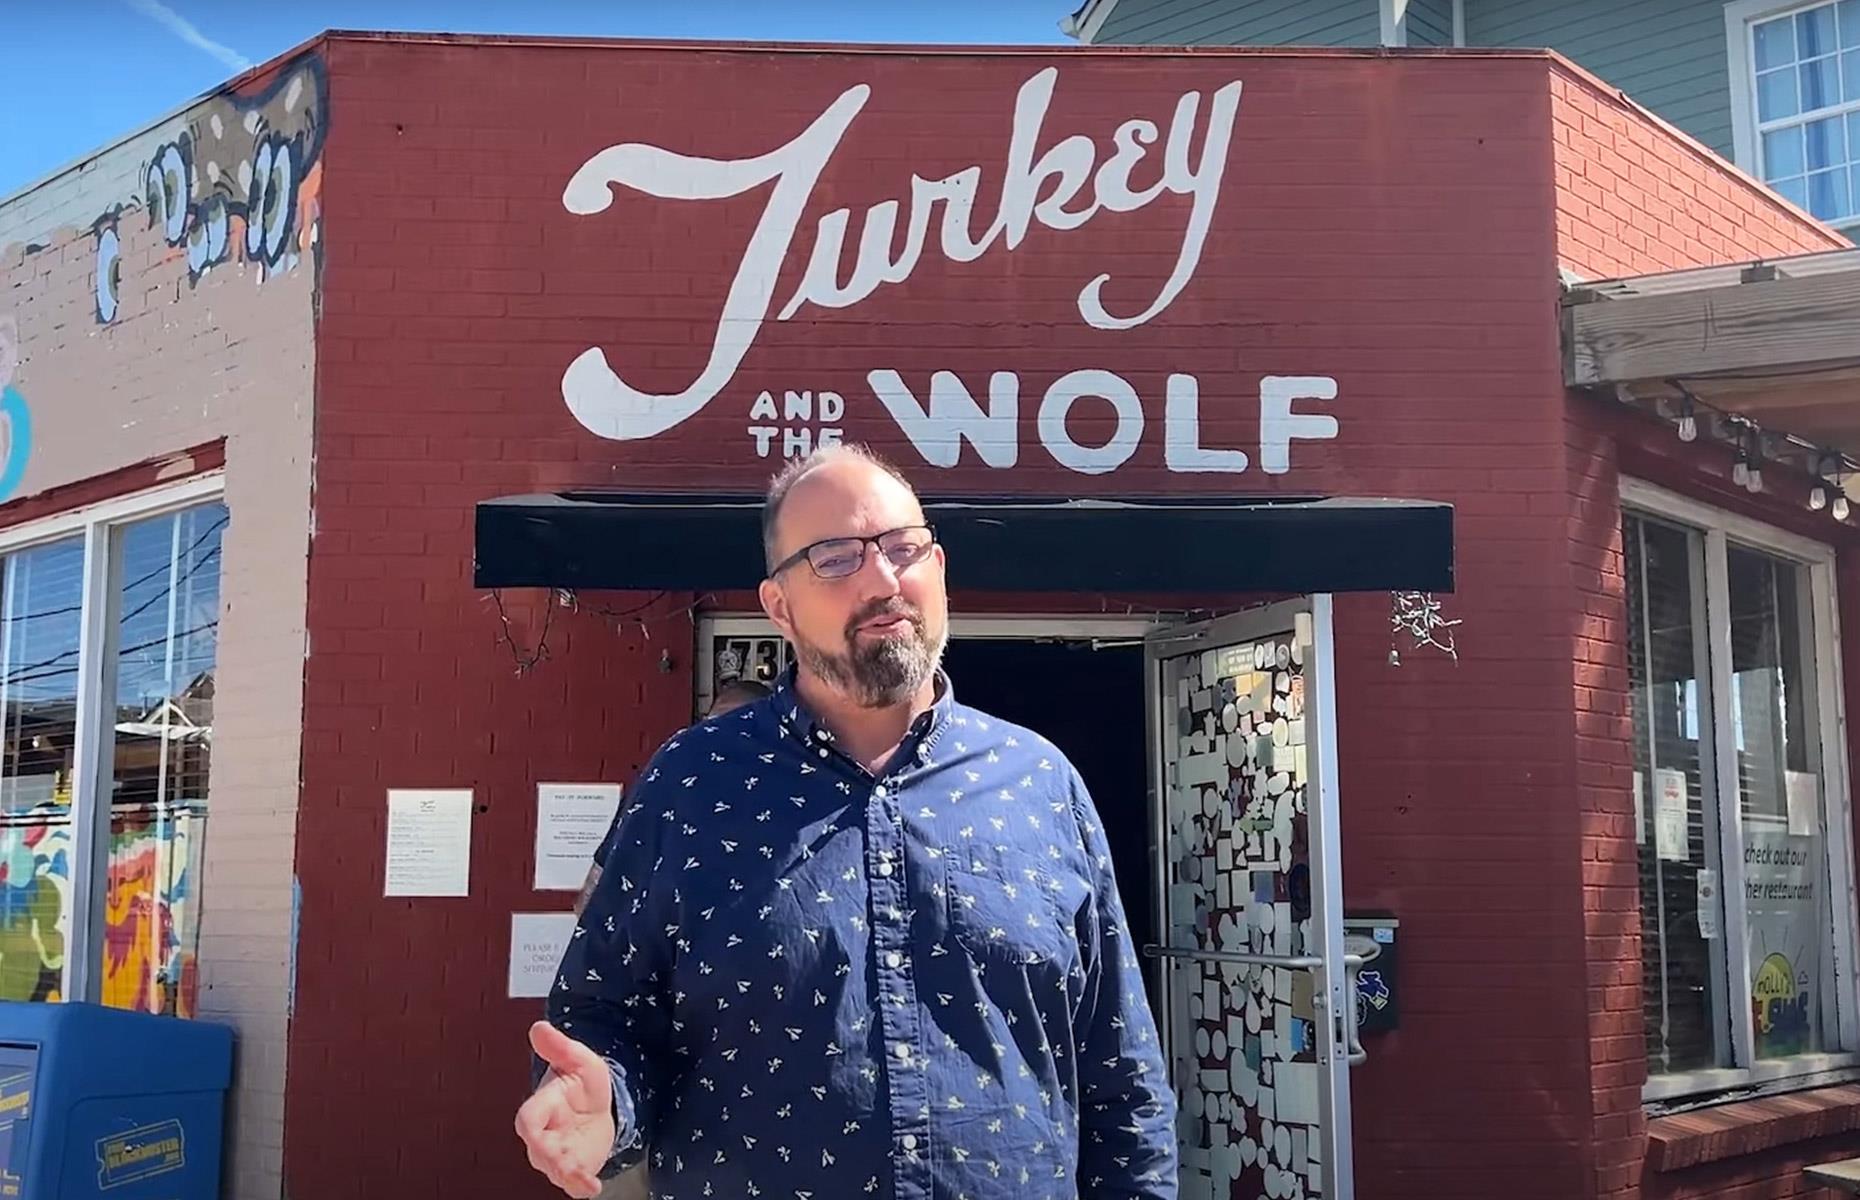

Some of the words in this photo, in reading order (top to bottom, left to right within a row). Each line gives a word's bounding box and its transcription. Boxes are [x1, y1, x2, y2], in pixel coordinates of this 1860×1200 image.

[562, 66, 1243, 441] Turkey
[749, 390, 845, 422] AND
[867, 368, 1339, 475] WOLF
[748, 425, 844, 458] THE
[1744, 841, 1772, 864] check
[1773, 847, 1790, 865] out
[1791, 850, 1807, 866] our
[1744, 877, 1762, 899] her
[1763, 881, 1813, 899] restaurant
